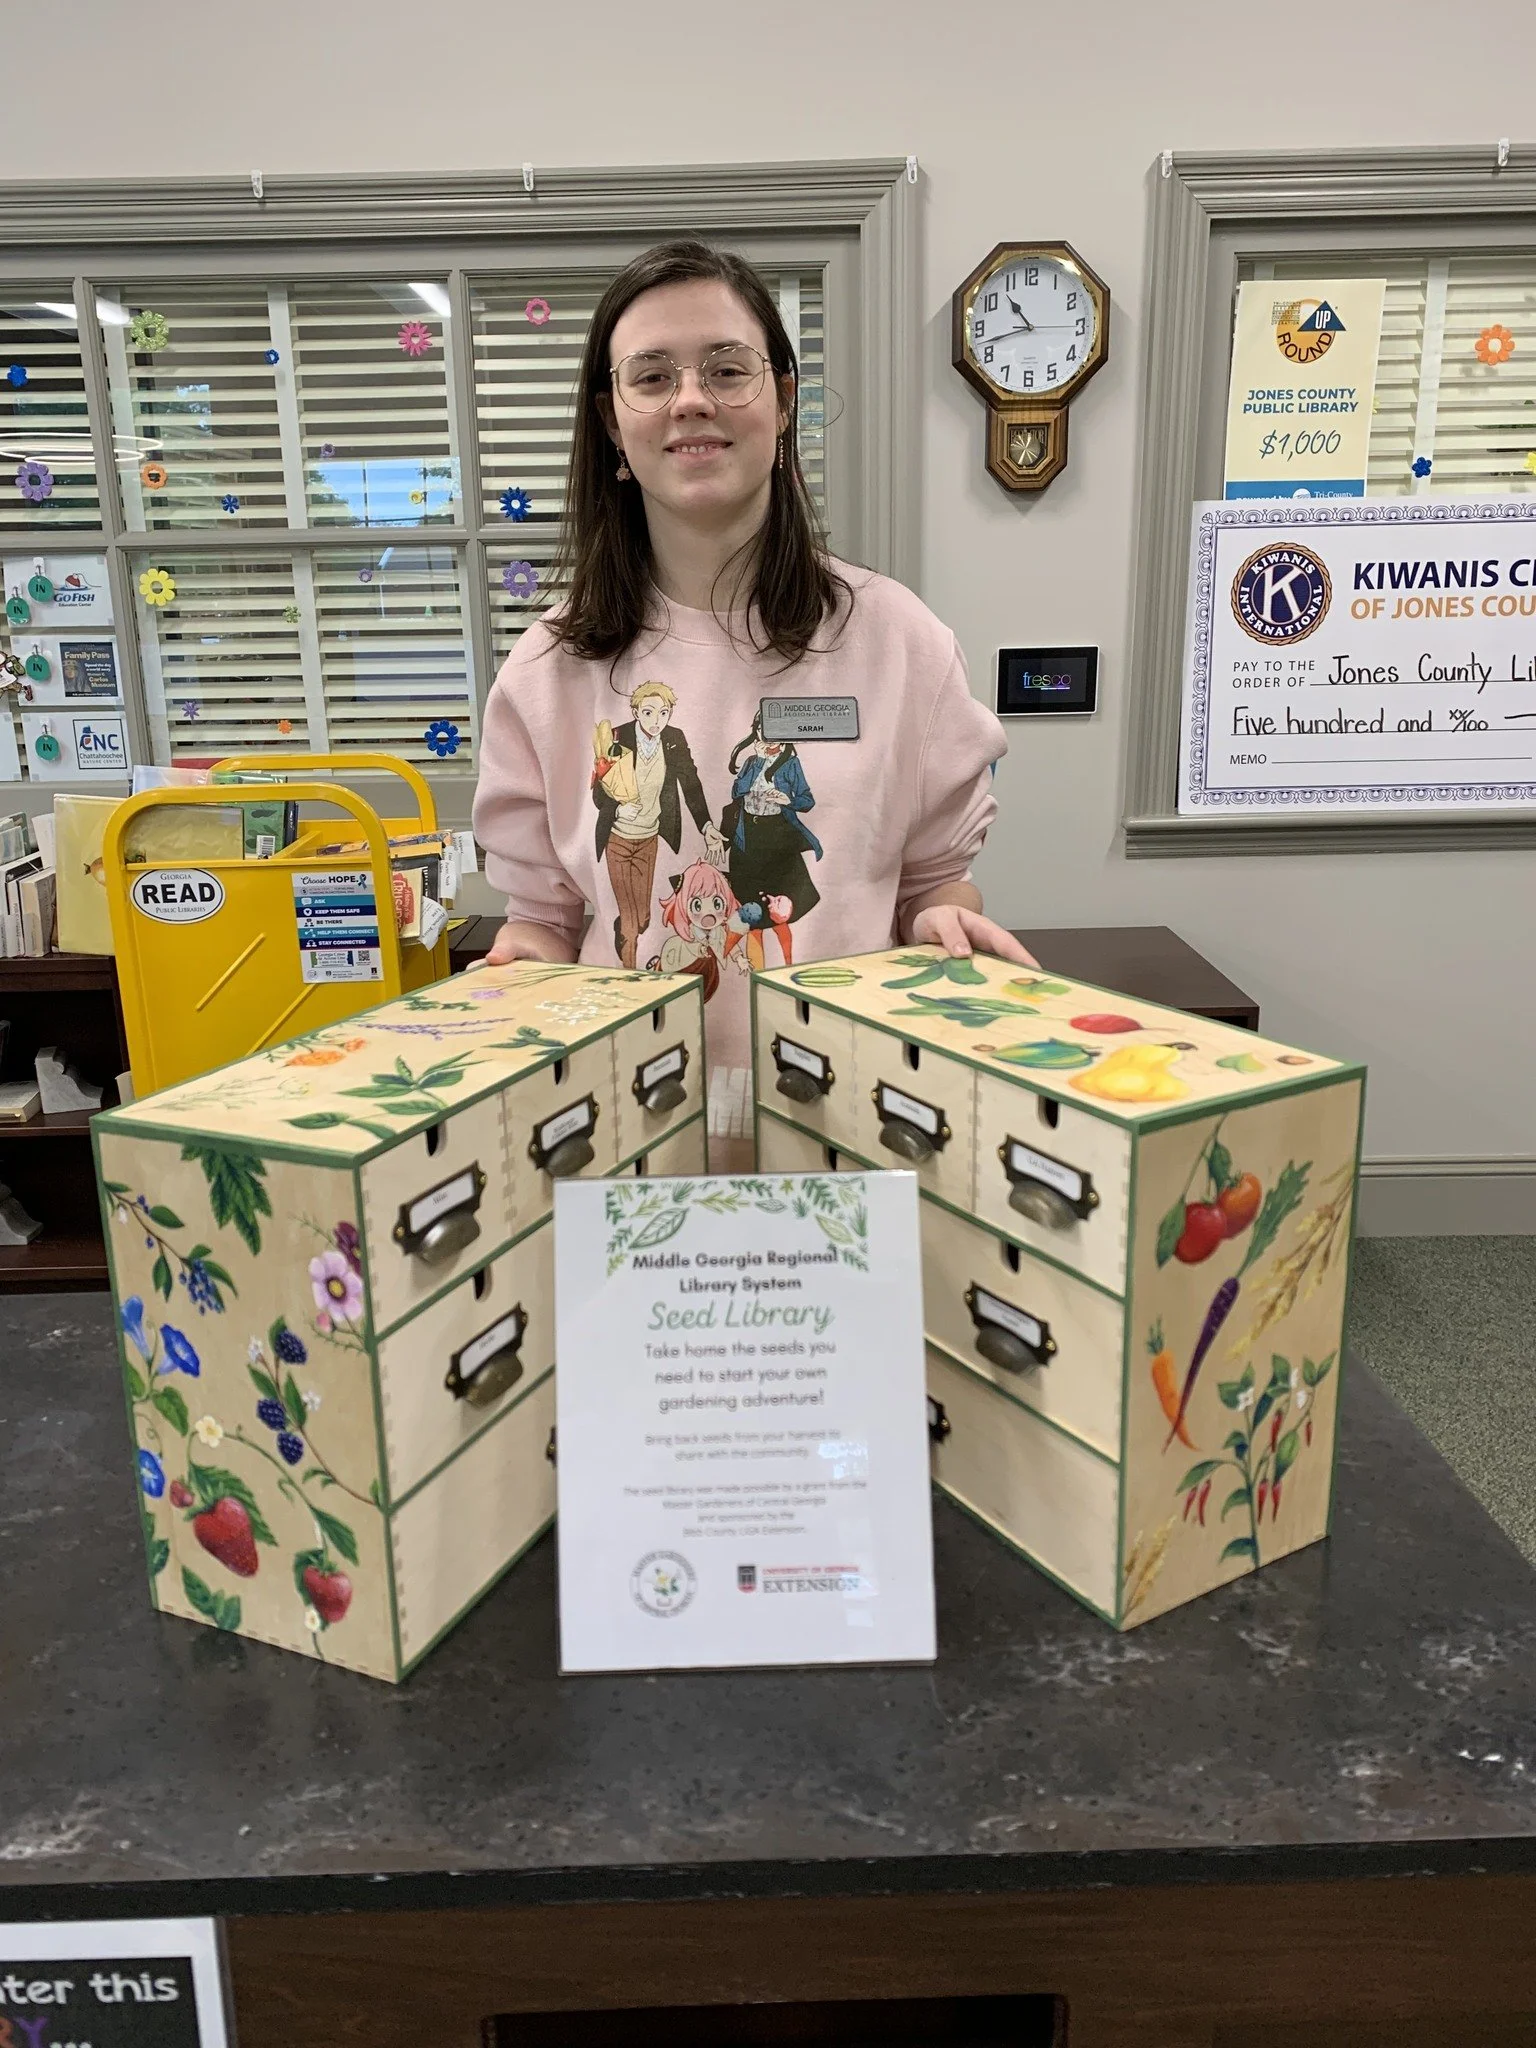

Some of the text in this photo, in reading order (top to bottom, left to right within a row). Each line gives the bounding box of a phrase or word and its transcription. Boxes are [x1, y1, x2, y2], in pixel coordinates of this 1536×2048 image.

[1005, 272, 1016, 292] 11
[1024, 267, 1039, 286] 12
[984, 292, 998, 313] 10
[1066, 292, 1077, 311] 2
[975, 320, 985, 338] 9
[1075, 317, 1086, 336] 3
[1314, 310, 1331, 329] UP
[984, 345, 994, 364] 8
[1066, 344, 1077, 362] 4
[1277, 331, 1333, 362] ROUND
[1000, 365, 1011, 383] 7
[1023, 370, 1034, 388] 6
[1046, 363, 1057, 382] 5
[1247, 388, 1356, 401] JONES COUNTY
[1243, 401, 1359, 414] PUBLIC LIBRARY
[1259, 429, 1342, 462] $1,000
[1251, 552, 1316, 575] KIWANIS
[1353, 559, 1499, 590] KIWANIS
[35, 584, 46, 593] IN
[1261, 563, 1304, 625] K
[13, 606, 23, 615] IN
[1240, 585, 1323, 637] INTERNATIONAL
[1351, 598, 1385, 620] OF
[1391, 596, 1474, 620] JONES
[65, 652, 91, 660] Family
[32, 663, 43, 672] IN
[1234, 660, 1315, 672] PAY TO THE
[1328, 652, 1536, 694] Jones County Li
[1022, 671, 1072, 687] fresco
[1232, 677, 1305, 688] ORDER OF
[784, 703, 850, 712] MIDDLE GEORGIA
[1233, 706, 1277, 736] Five
[1286, 706, 1384, 735] hundred
[1397, 710, 1432, 733] and
[42, 743, 52, 752] IN
[79, 752, 124, 760] Chattahoochee
[1229, 754, 1267, 765] MEMO
[328, 875, 359, 884] HOPE.
[141, 882, 215, 904] READ
[155, 906, 177, 914] PUBLIC
[632, 1250, 838, 1271] Middle Georgia Regional
[679, 1276, 802, 1296] Library System
[648, 1299, 835, 1336] Seed Library
[645, 1339, 837, 1358] Take home the seeds you
[655, 1366, 827, 1385] need to start your own
[659, 1388, 825, 1414] gardening adventure!
[763, 1578, 861, 1593] EXTENSION
[0, 1972, 180, 2005] ter this
